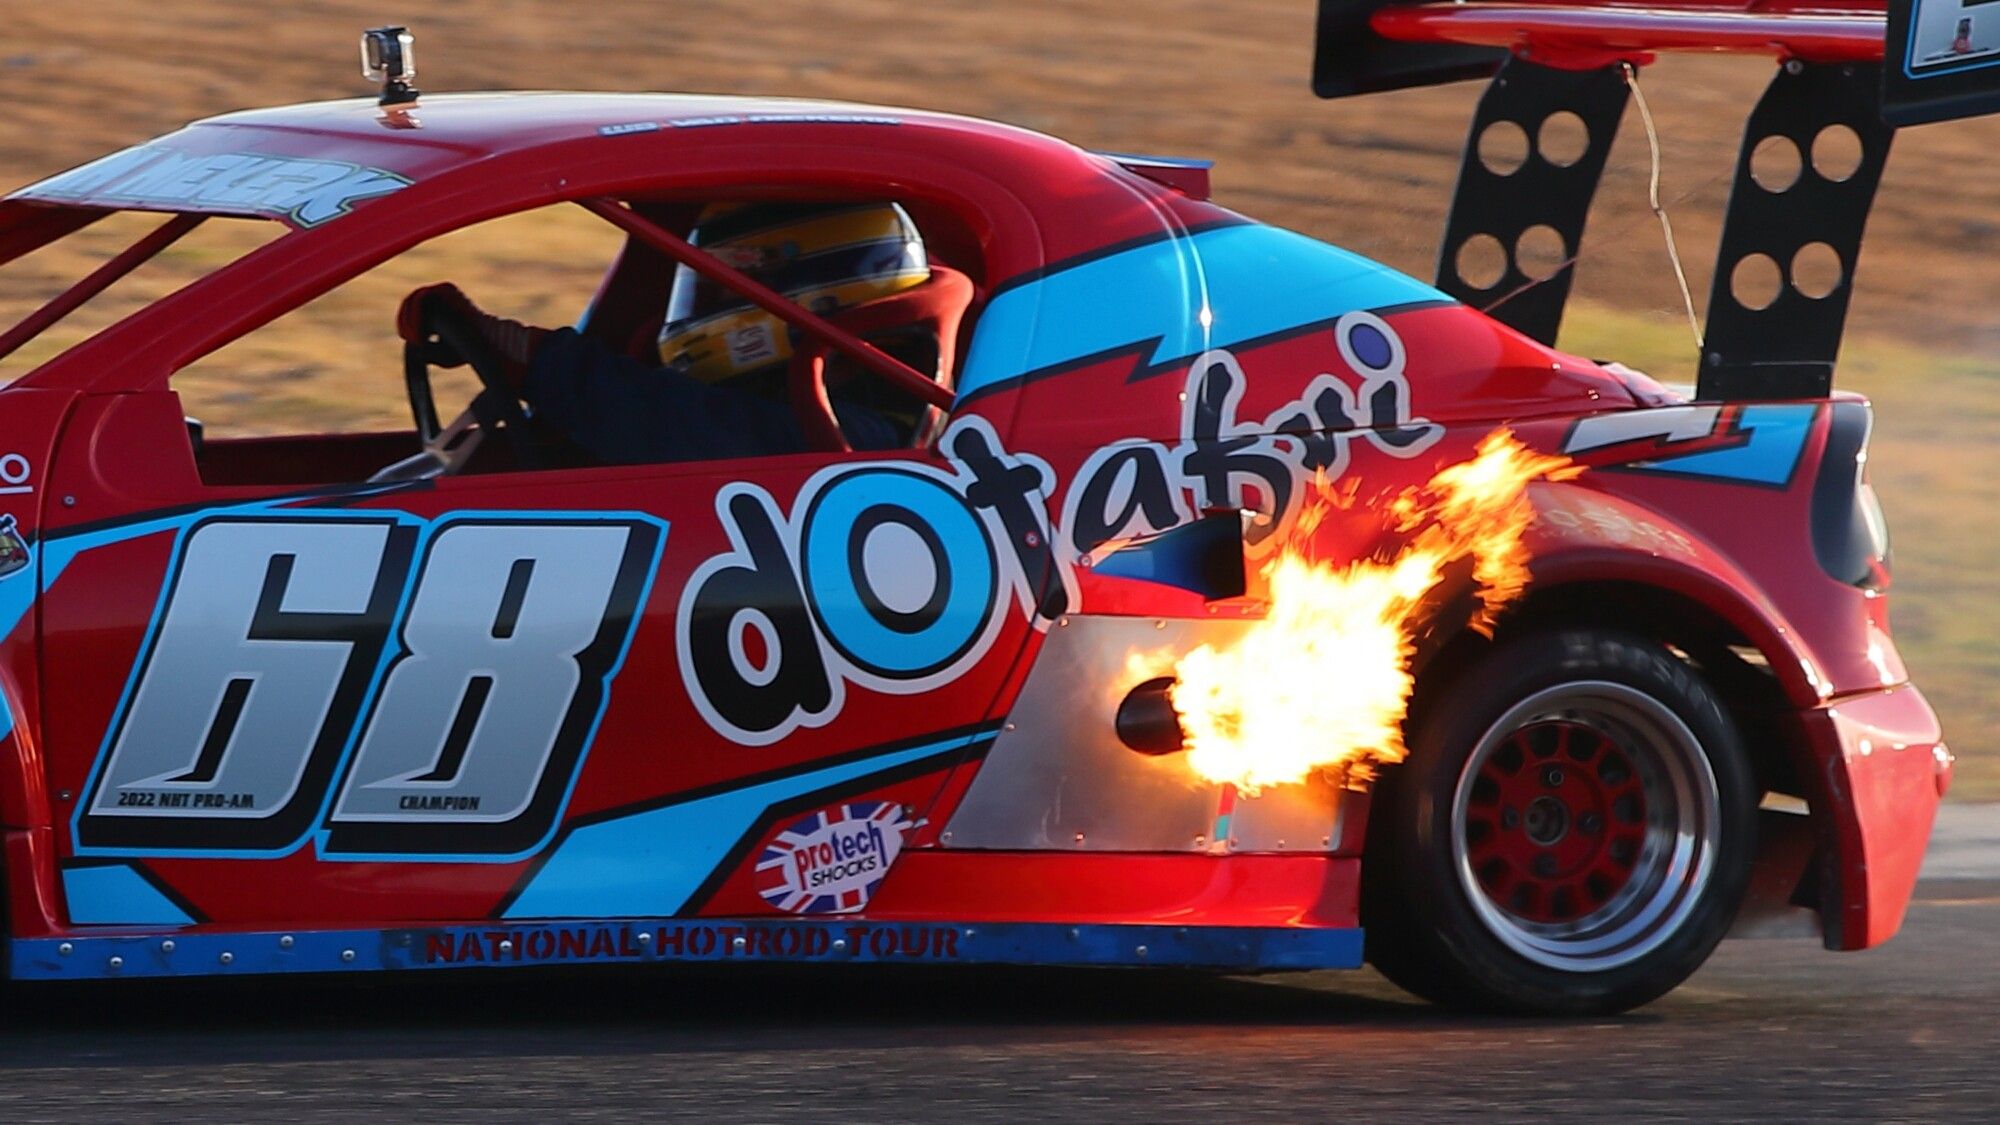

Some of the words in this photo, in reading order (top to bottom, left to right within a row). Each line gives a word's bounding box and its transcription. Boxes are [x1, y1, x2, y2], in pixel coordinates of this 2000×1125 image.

[88, 522, 631, 822] 68
[118, 792, 155, 806] 2022
[158, 793, 190, 807] NHT
[193, 794, 254, 808] PRO-AM
[399, 795, 480, 810] CHAMPION
[794, 821, 887, 891] protech
[811, 855, 877, 887] SHOCKS
[426, 927, 640, 963] NATIONAL
[656, 926, 831, 957] HOTROD
[845, 927, 959, 958] TOUR
